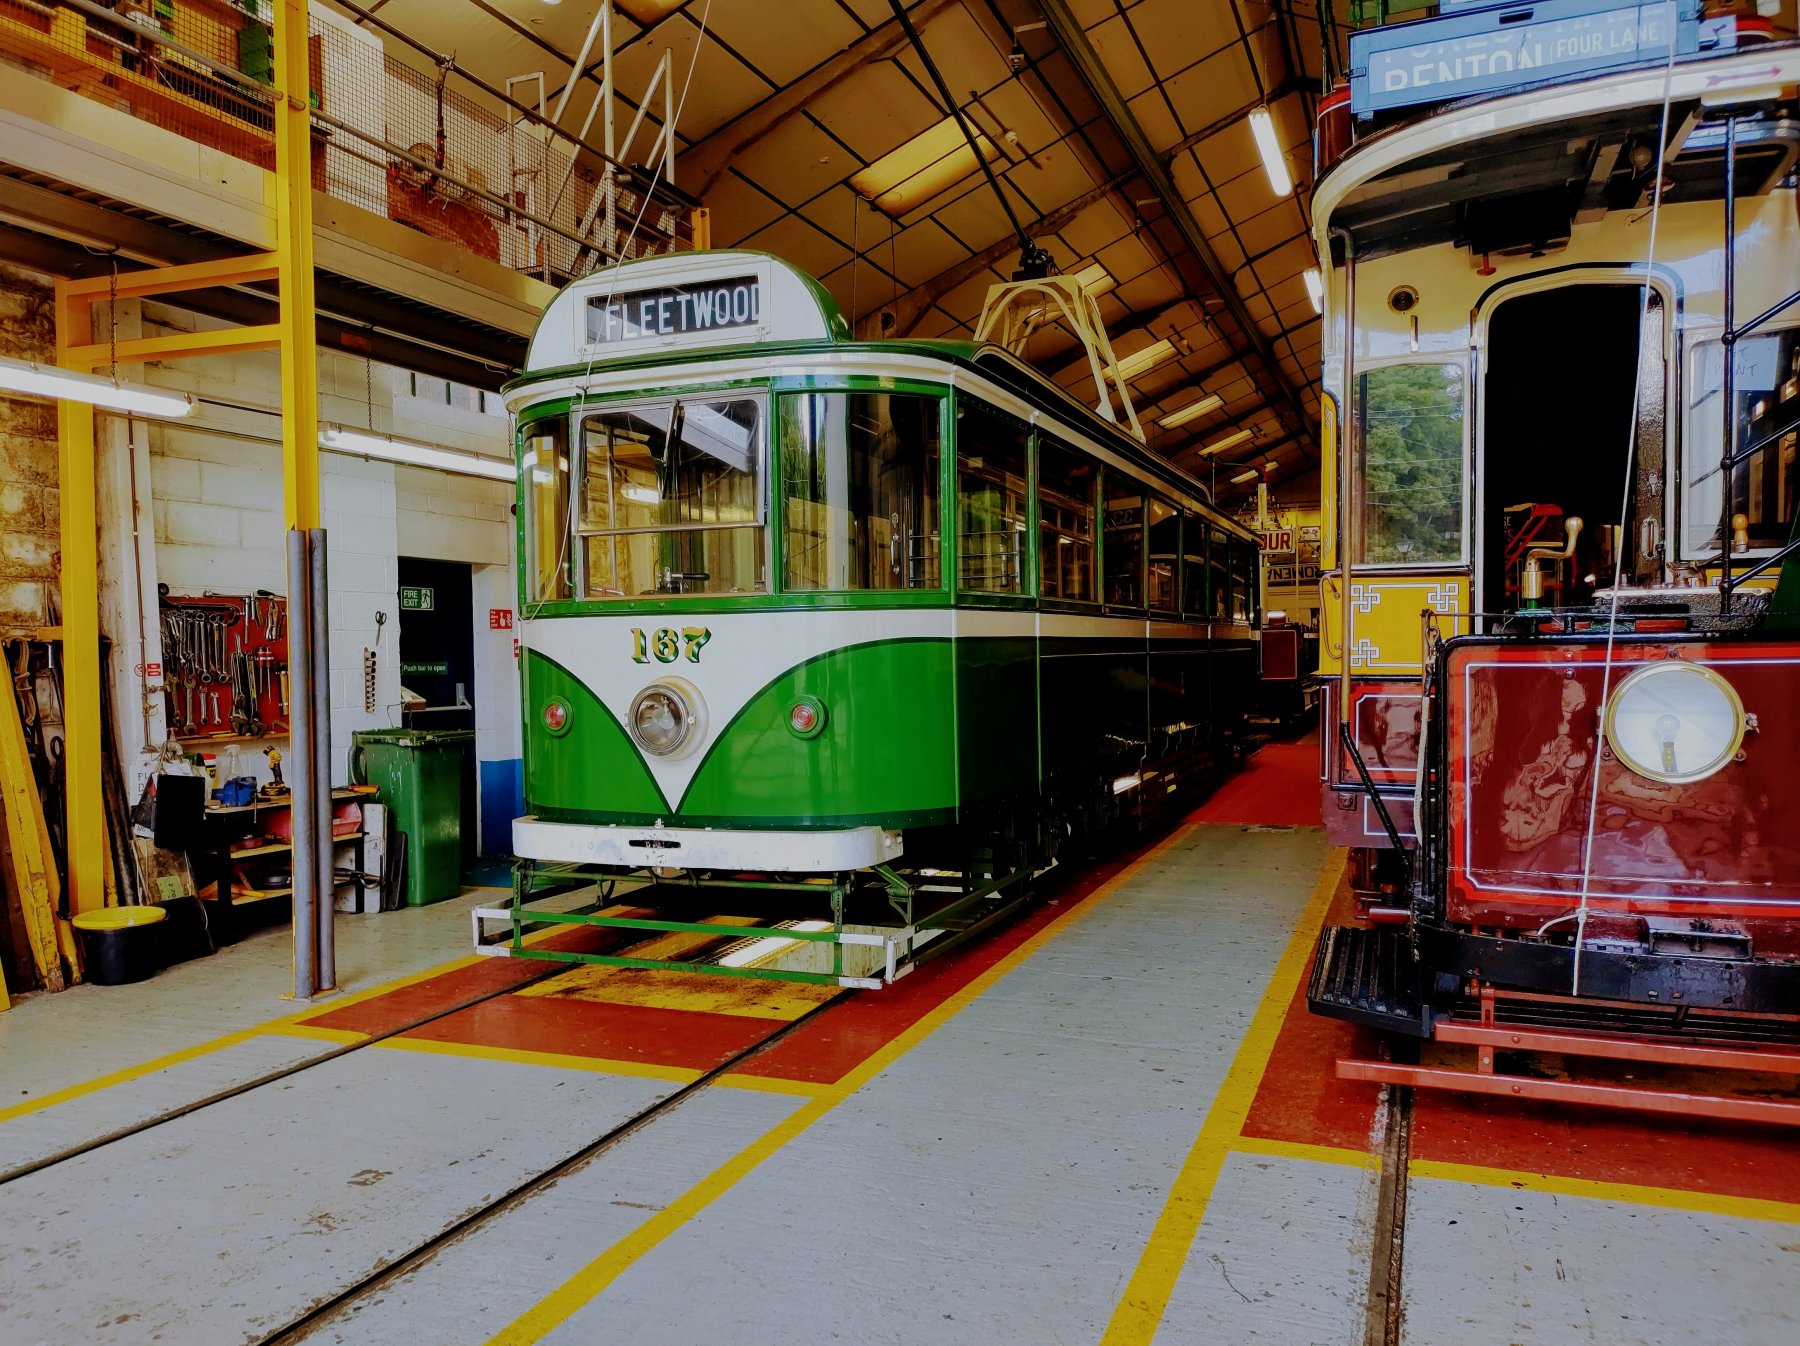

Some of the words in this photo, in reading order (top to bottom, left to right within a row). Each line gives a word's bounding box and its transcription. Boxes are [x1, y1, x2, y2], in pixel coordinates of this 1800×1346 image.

[403, 590, 418, 598] FIRE
[403, 599, 418, 607] EXIT
[630, 626, 712, 664] 167
[403, 664, 417, 672] Push
[418, 664, 427, 672] bar
[428, 664, 433, 672] to
[434, 665, 446, 673] open
